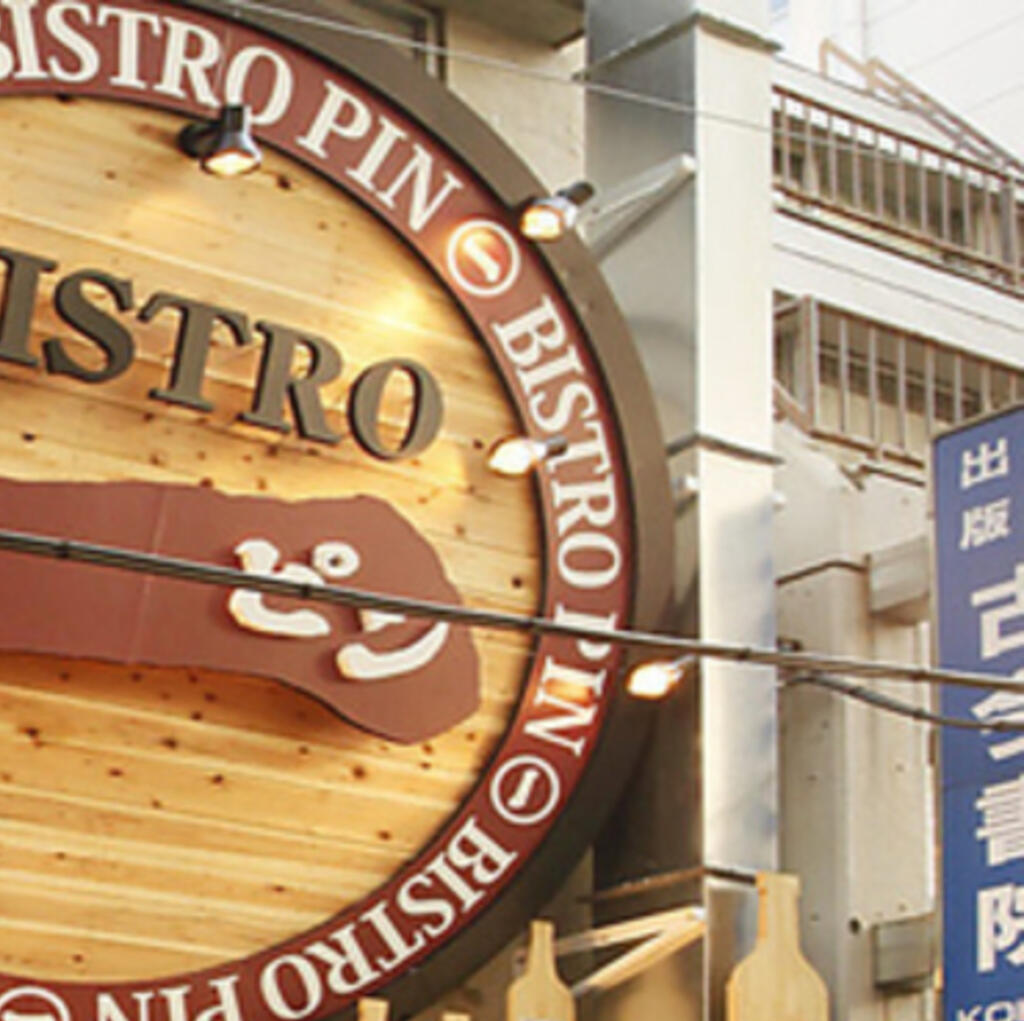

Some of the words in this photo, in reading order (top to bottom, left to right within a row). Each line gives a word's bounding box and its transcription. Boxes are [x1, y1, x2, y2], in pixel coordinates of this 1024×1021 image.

[297, 80, 462, 232] PIN
[492, 295, 621, 589] BISTRO
[524, 603, 618, 756] PIN
[260, 818, 517, 1021] BISTRO
